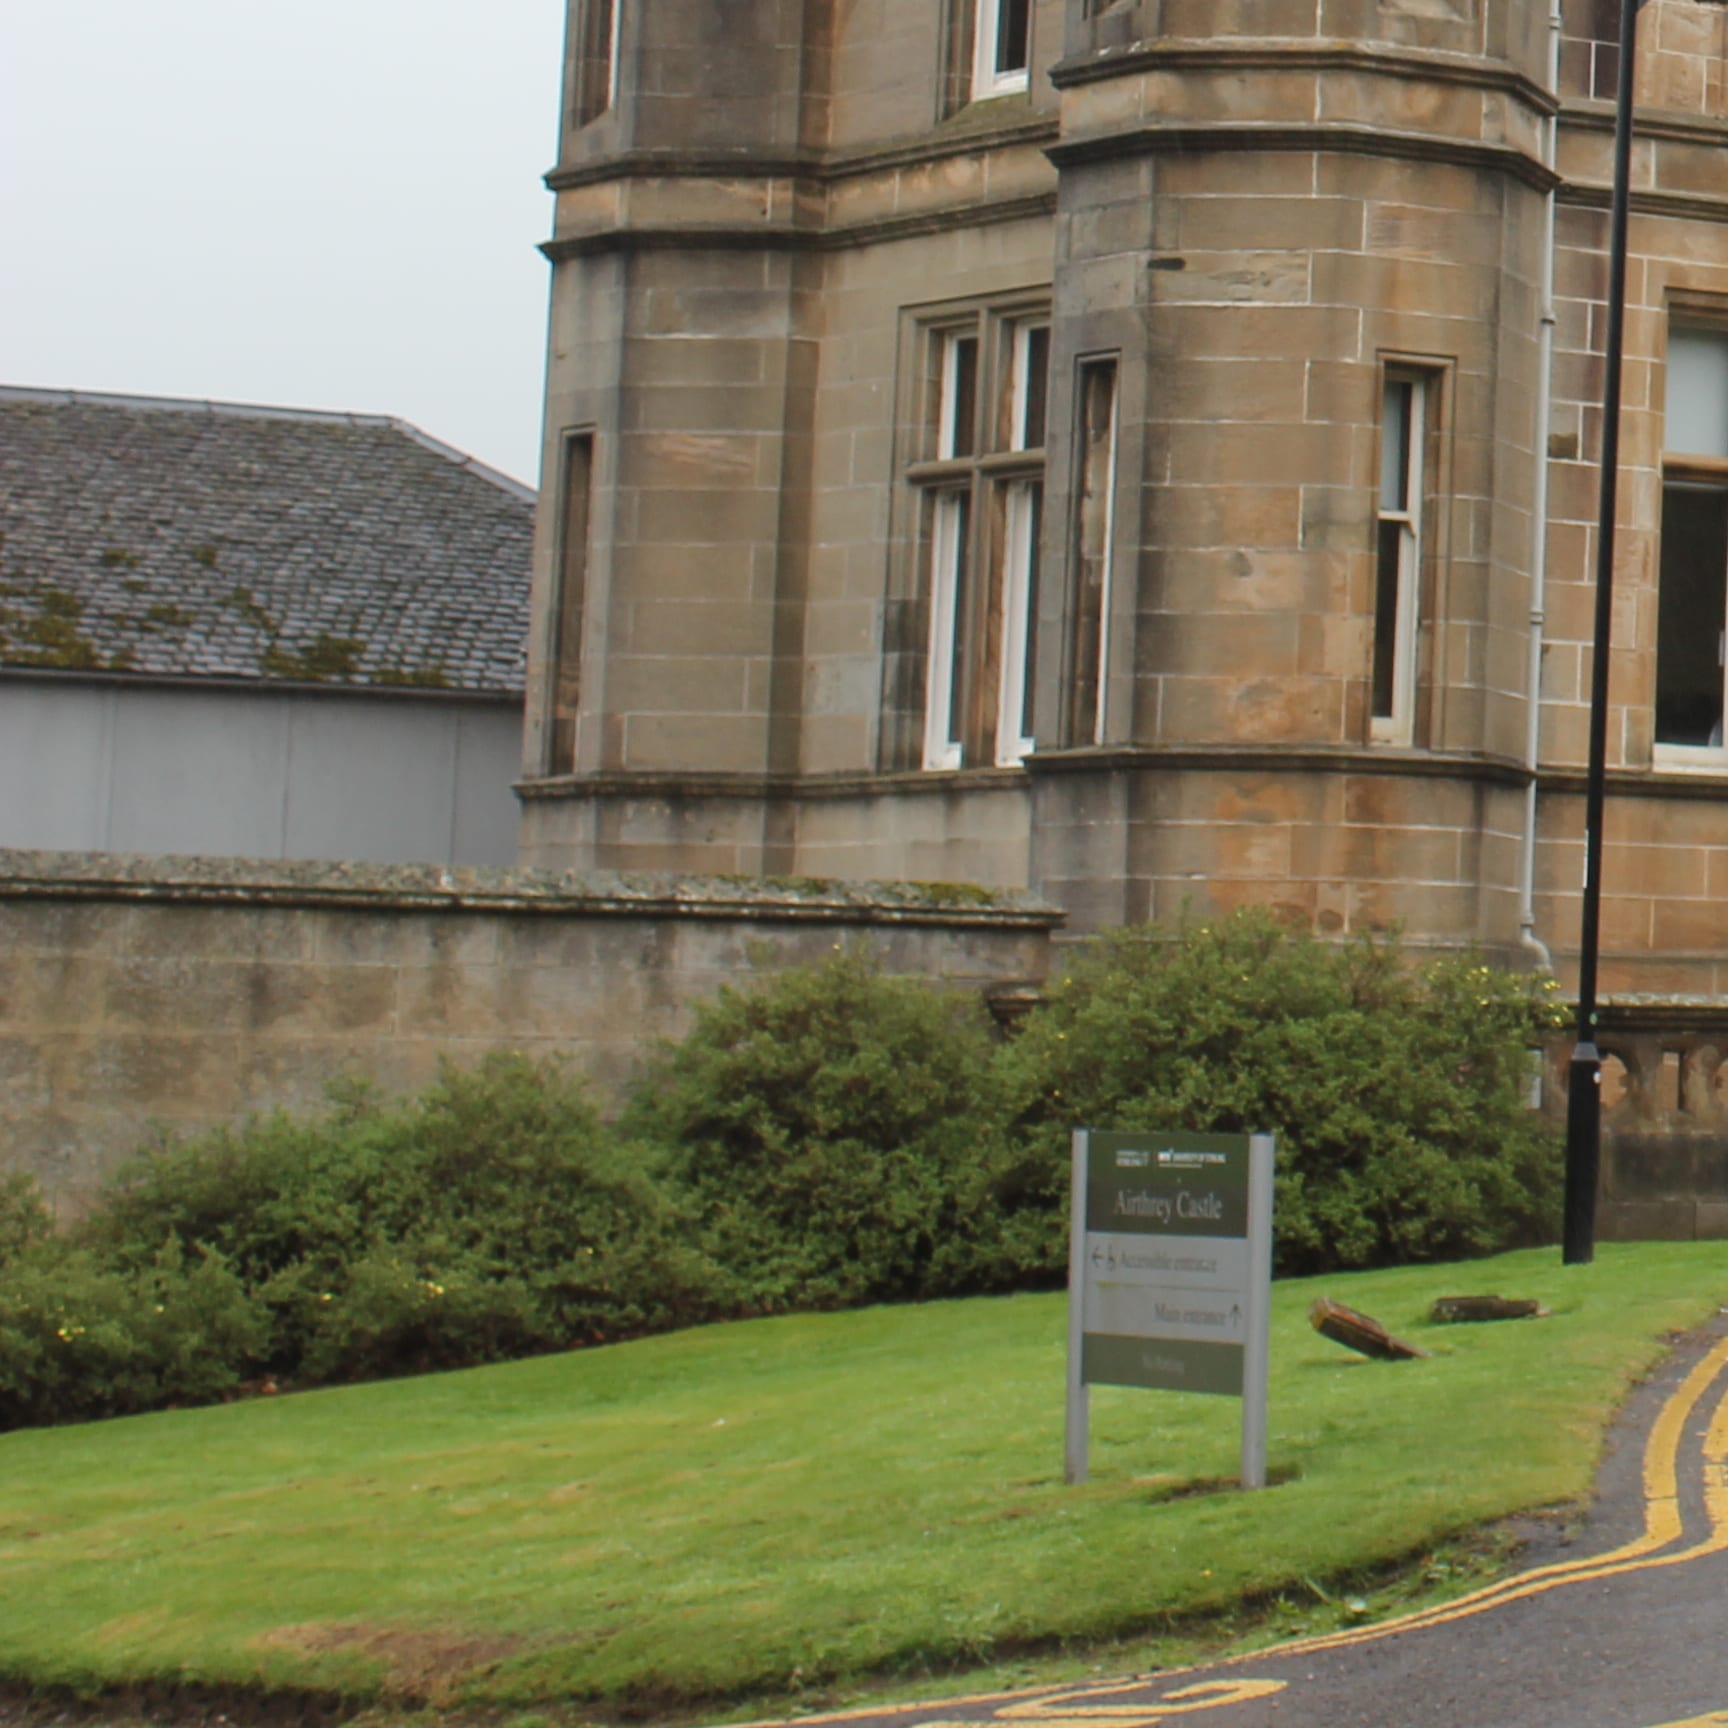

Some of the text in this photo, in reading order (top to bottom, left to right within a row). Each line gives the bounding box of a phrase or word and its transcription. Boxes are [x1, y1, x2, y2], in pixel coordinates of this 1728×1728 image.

[1113, 1189, 1223, 1223] Airthrey Castle
[1153, 1302, 1181, 1322] Main
